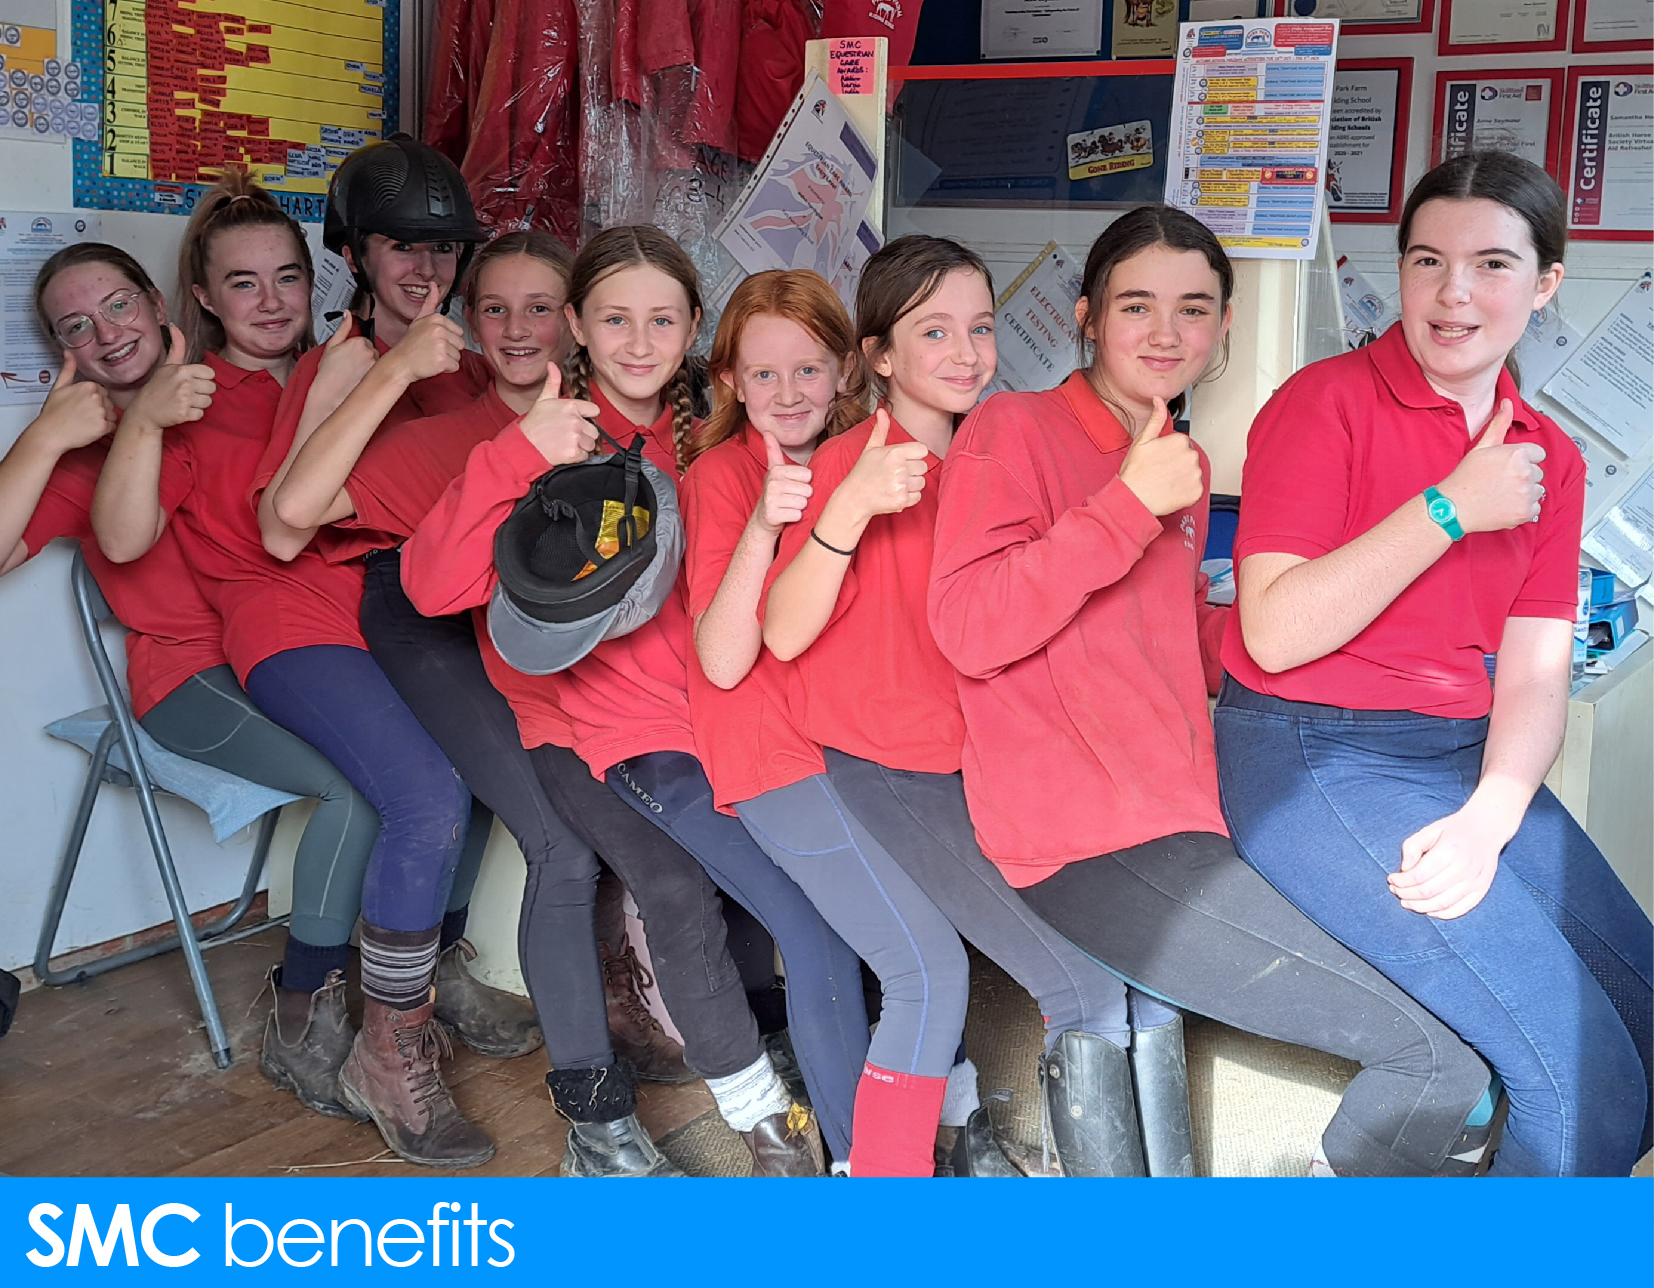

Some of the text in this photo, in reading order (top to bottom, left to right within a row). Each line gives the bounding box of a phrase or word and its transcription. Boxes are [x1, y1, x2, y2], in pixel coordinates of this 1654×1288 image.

[108, 22, 116, 46] 6
[830, 50, 875, 60] EQUESTRIAN
[840, 41, 861, 50] SMC
[107, 49, 115, 71] 5
[107, 76, 116, 99] 4
[1335, 85, 1368, 95] Park Farm
[107, 101, 116, 123] 3
[1334, 96, 1372, 106] iding School
[1344, 106, 1374, 115] accredited
[1347, 123, 1371, 131] Schools
[1580, 86, 1602, 190] Certificate
[107, 128, 117, 151] 2
[108, 151, 117, 175] 1
[1088, 159, 1135, 174] GONE RIDING
[279, 196, 326, 216] HART
[1030, 286, 1076, 344] ELECTRICAL
[1026, 308, 1059, 348] TESTING
[1004, 312, 1055, 372] CERTIFICATE
